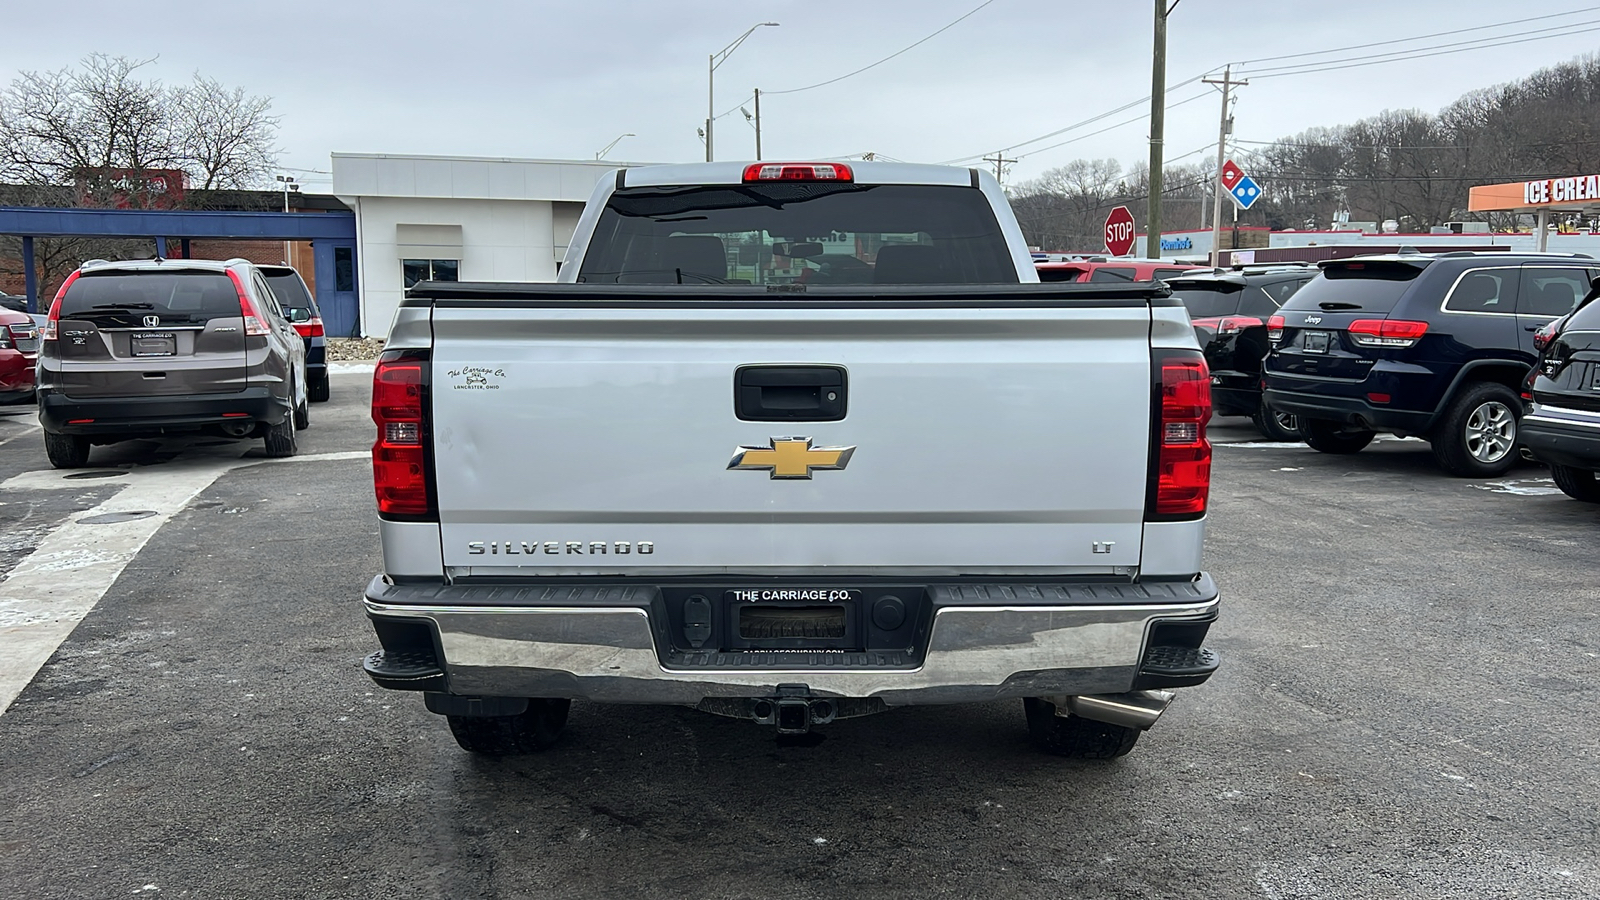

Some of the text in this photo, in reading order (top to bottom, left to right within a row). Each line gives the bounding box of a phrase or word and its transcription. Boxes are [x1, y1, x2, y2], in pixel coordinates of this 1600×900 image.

[1524, 174, 1600, 204] ICE CREA
[1107, 221, 1133, 243] STOP
[1160, 237, 1192, 250] Domino's
[1305, 315, 1322, 324] Jeep
[448, 370, 460, 378] The
[462, 366, 493, 375] Carriage
[468, 541, 654, 555] SILVERADO
[1092, 541, 1116, 554] LT
[734, 590, 851, 600] THE CARRIAGE CO.
